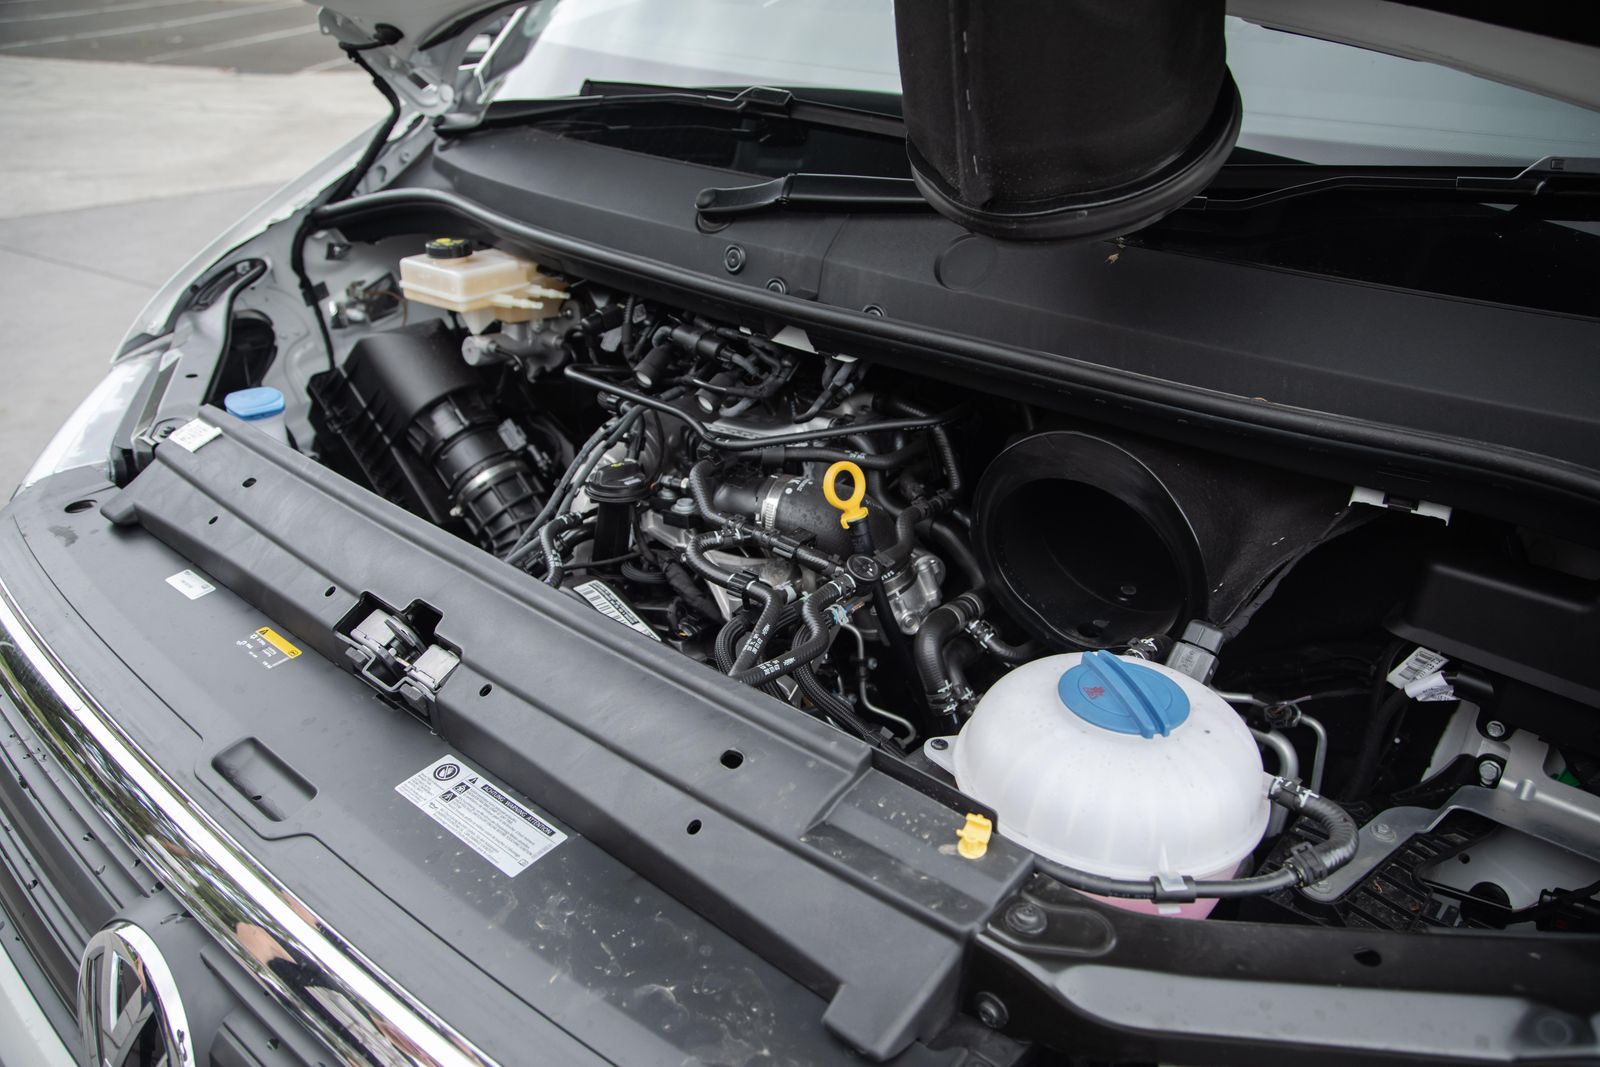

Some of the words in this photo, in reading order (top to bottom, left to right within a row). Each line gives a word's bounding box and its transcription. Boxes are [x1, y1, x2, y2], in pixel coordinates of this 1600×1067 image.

[484, 786, 505, 803] ACHTUNG
[505, 799, 527, 818] WARNING
[526, 814, 552, 835] ATTENTION
